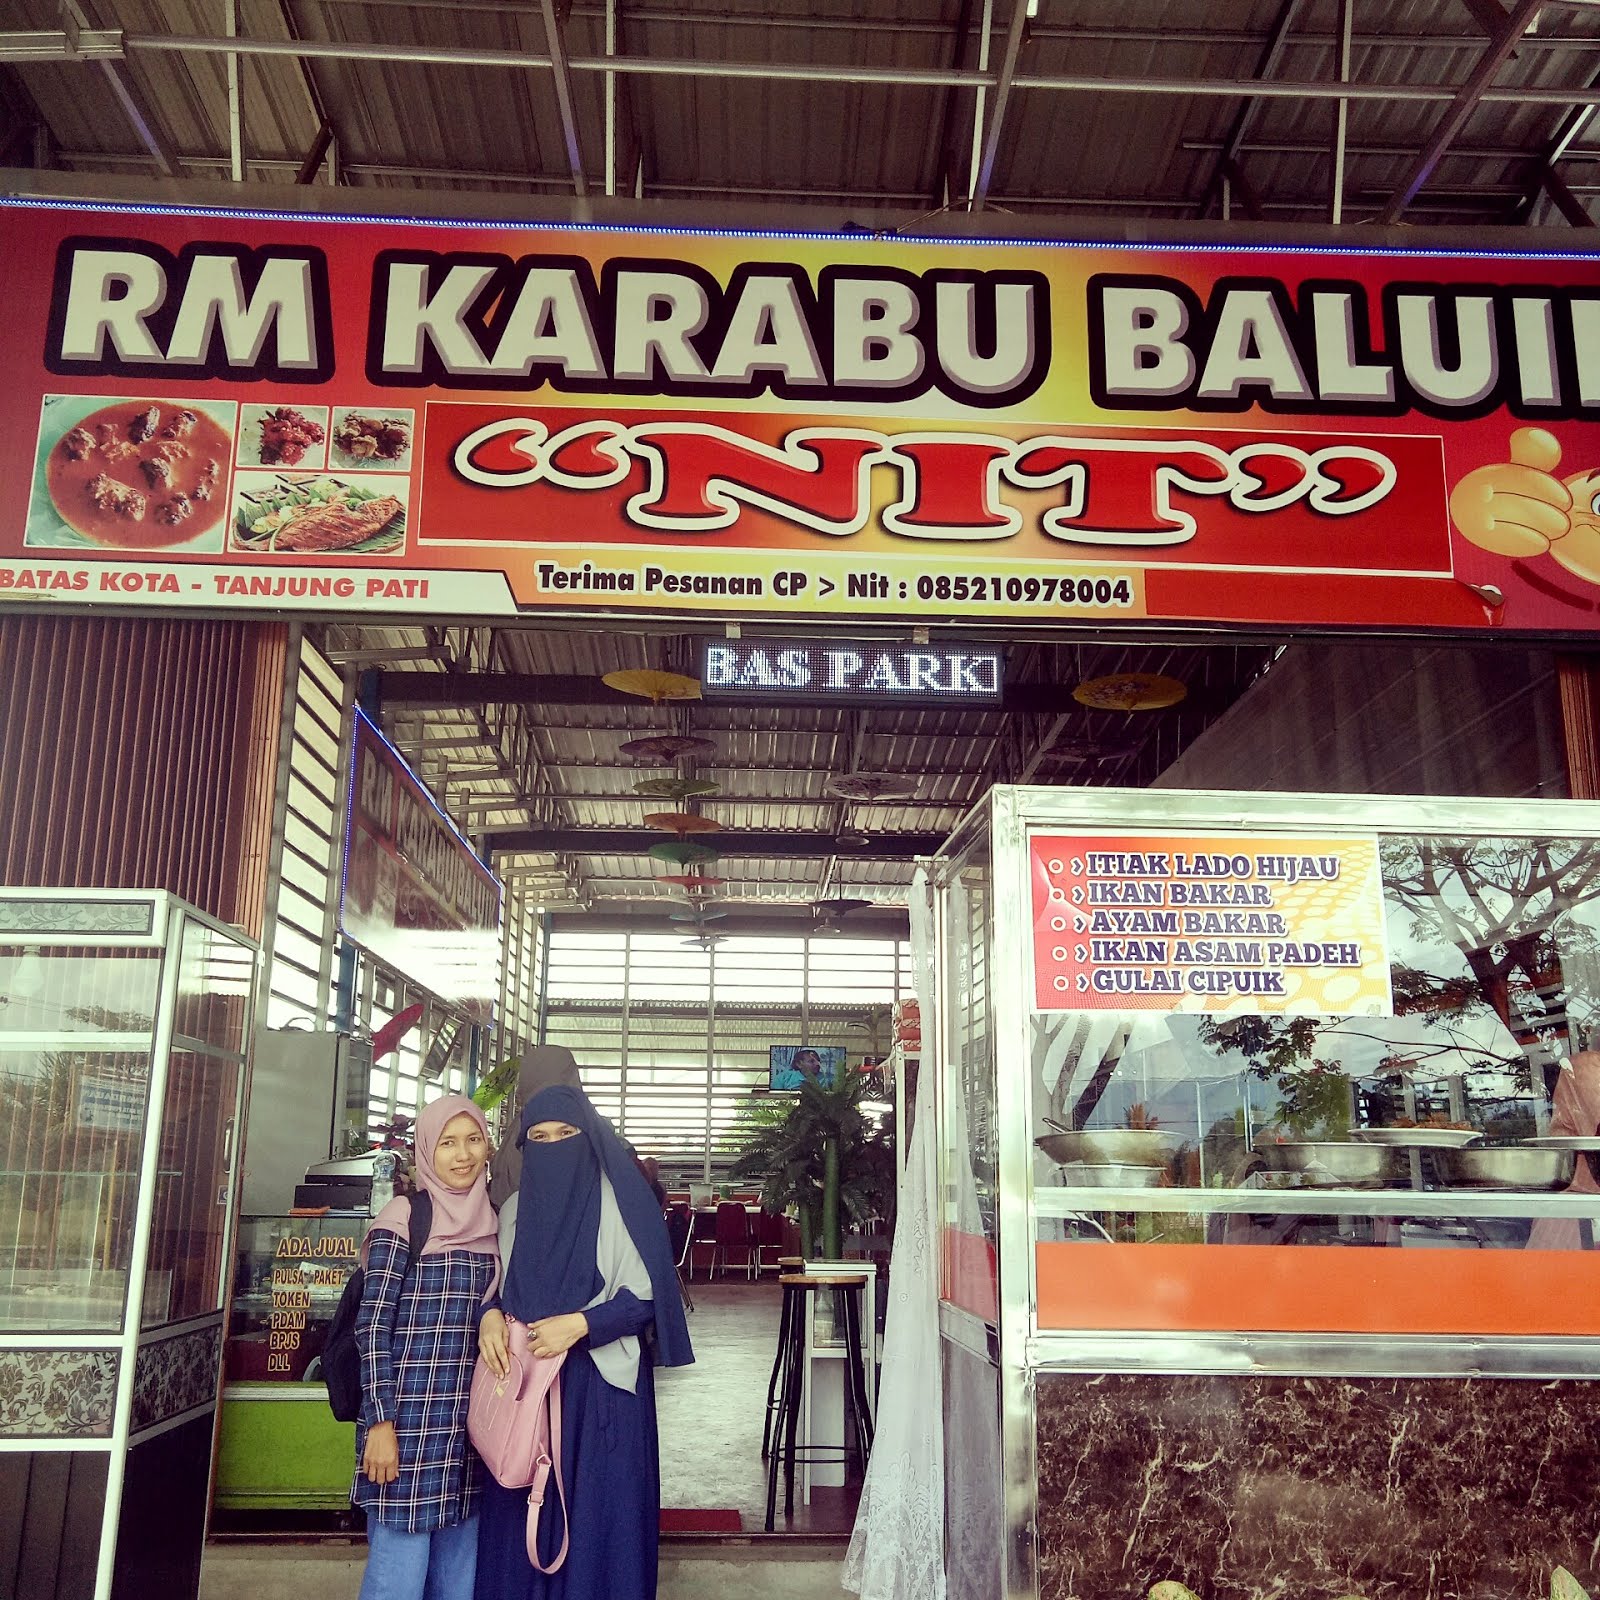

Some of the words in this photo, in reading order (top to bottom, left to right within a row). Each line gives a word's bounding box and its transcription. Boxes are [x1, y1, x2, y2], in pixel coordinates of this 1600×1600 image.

[59, 248, 319, 371] RM
[380, 262, 1037, 394] KARABU
[0, 568, 89, 591] BATAS
[99, 571, 181, 594] KOTA
[213, 575, 356, 598] TANJUNG
[365, 578, 430, 599] PATI
[538, 564, 635, 592] Terima
[644, 567, 763, 596] Pesanan
[772, 572, 808, 597] CP
[847, 573, 889, 599] Nit
[916, 574, 1131, 604] 085210978004
[1087, 853, 1170, 877] ITIAK
[1175, 855, 1251, 877] LADO
[1256, 856, 1338, 882] HIJAU
[1089, 882, 1163, 904] IKAN
[1169, 883, 1272, 906] BAKAR
[1091, 911, 1178, 934] AYAM
[1184, 912, 1287, 935] BAKAR
[1091, 940, 1166, 963] IKAN
[1173, 941, 1263, 963] ASAM
[1268, 943, 1360, 965] PADEH
[1093, 969, 1182, 992] GULAI
[1187, 970, 1284, 993] CIPUIK
[276, 1237, 311, 1257] ADA
[314, 1237, 357, 1257] JUAL
[273, 1268, 304, 1285] PULSA
[313, 1268, 344, 1285] PAKET
[273, 1290, 311, 1308] TOKEN
[271, 1311, 306, 1329] PDAM
[270, 1331, 300, 1350] BPJS
[267, 1353, 290, 1371] DLL
